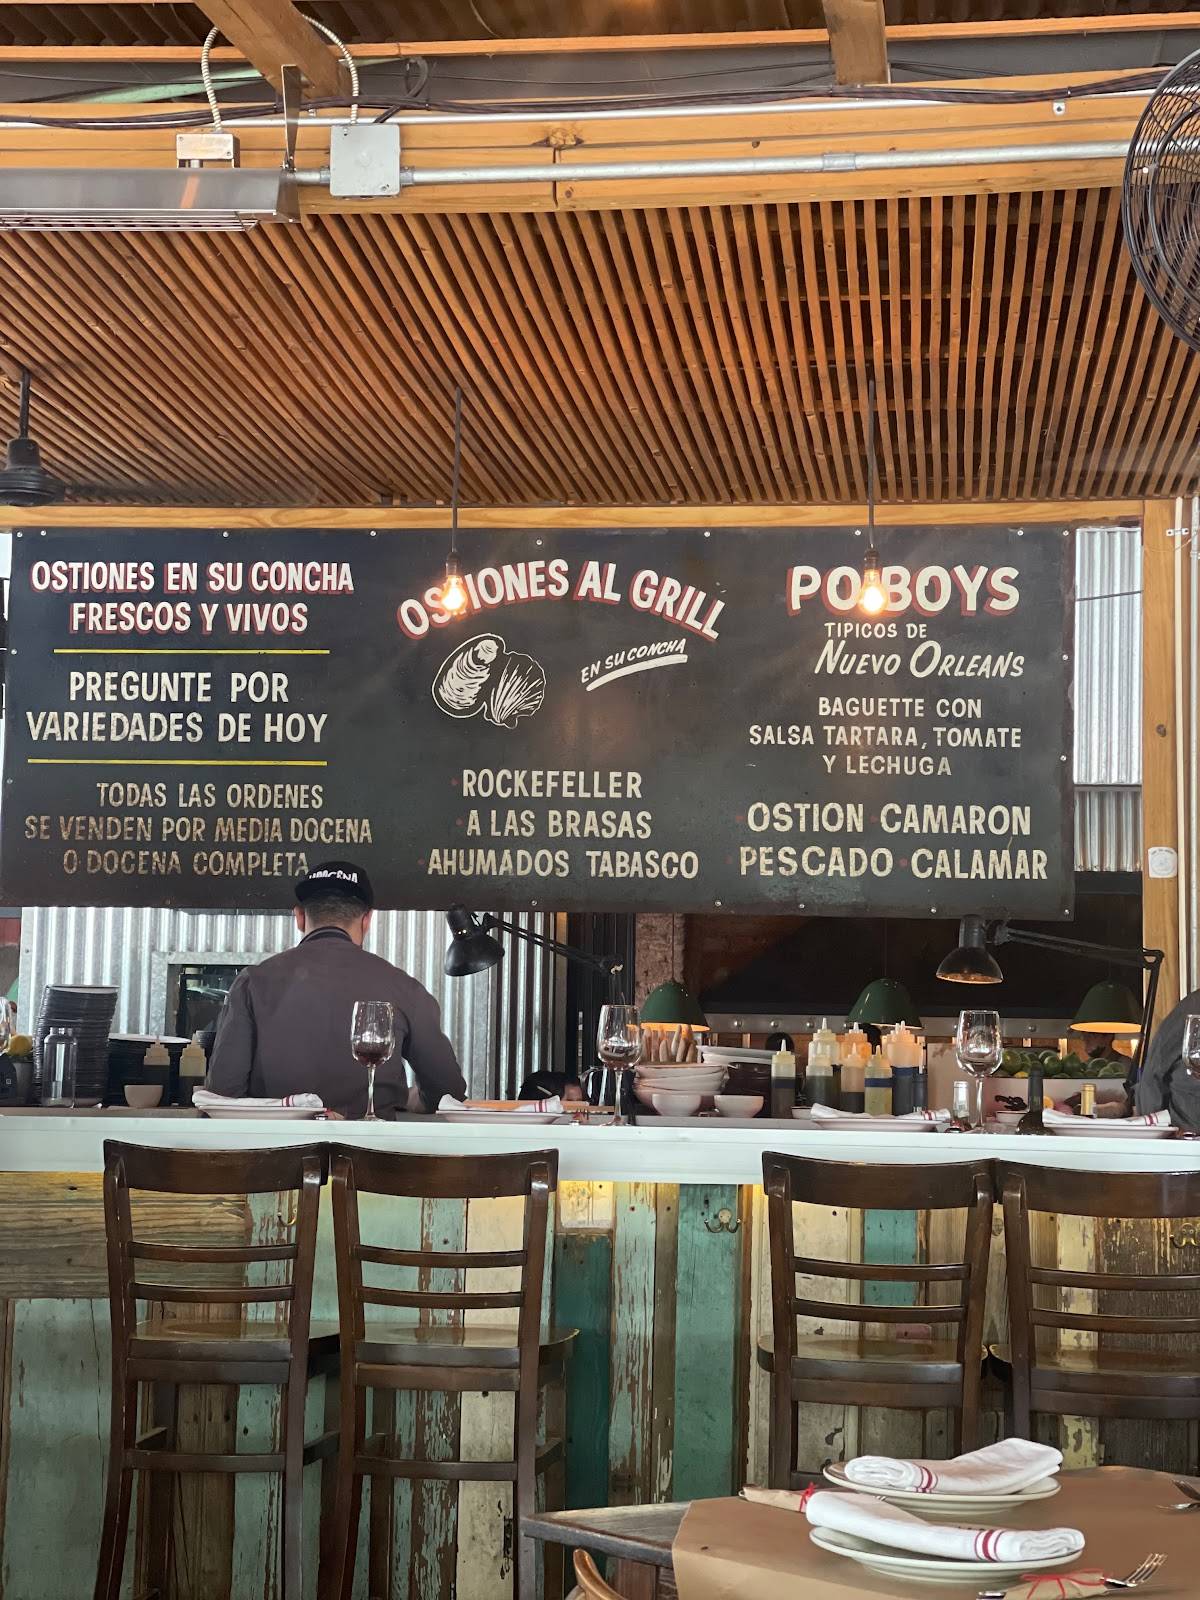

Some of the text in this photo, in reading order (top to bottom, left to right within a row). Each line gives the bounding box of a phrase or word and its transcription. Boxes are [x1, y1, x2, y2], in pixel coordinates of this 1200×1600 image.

[31, 560, 355, 592] OSTIONES EN SU CONCHA
[398, 558, 727, 641] OSIONES AL GRILL
[72, 601, 308, 632] FRESCOS Y VIVOS
[823, 622, 927, 639] TIPICOS DE
[580, 638, 687, 684] EN SU CONCHA
[69, 670, 289, 703] PREGUNTE POR
[818, 696, 982, 719] BAGUETTE CON
[25, 711, 328, 743] VARIEDADES DE HOY
[749, 724, 1022, 750] SALSA TARTARA, TOMATE
[822, 754, 952, 776] Y LECHUGA
[96, 781, 324, 809] TODAS LAS ORDENES
[462, 768, 642, 799] ROCKEFELLER
[24, 815, 373, 844] SE VENDEN POR MEDIA DOCENA
[466, 809, 652, 840] A LAS BRASAS
[747, 801, 1031, 836] OSTION CAMARON
[63, 849, 309, 877] O DOCENA COMPLETA
[427, 848, 699, 879] AHUMADOS TABASCO
[739, 845, 1048, 880] PESCADO CALAMAR
